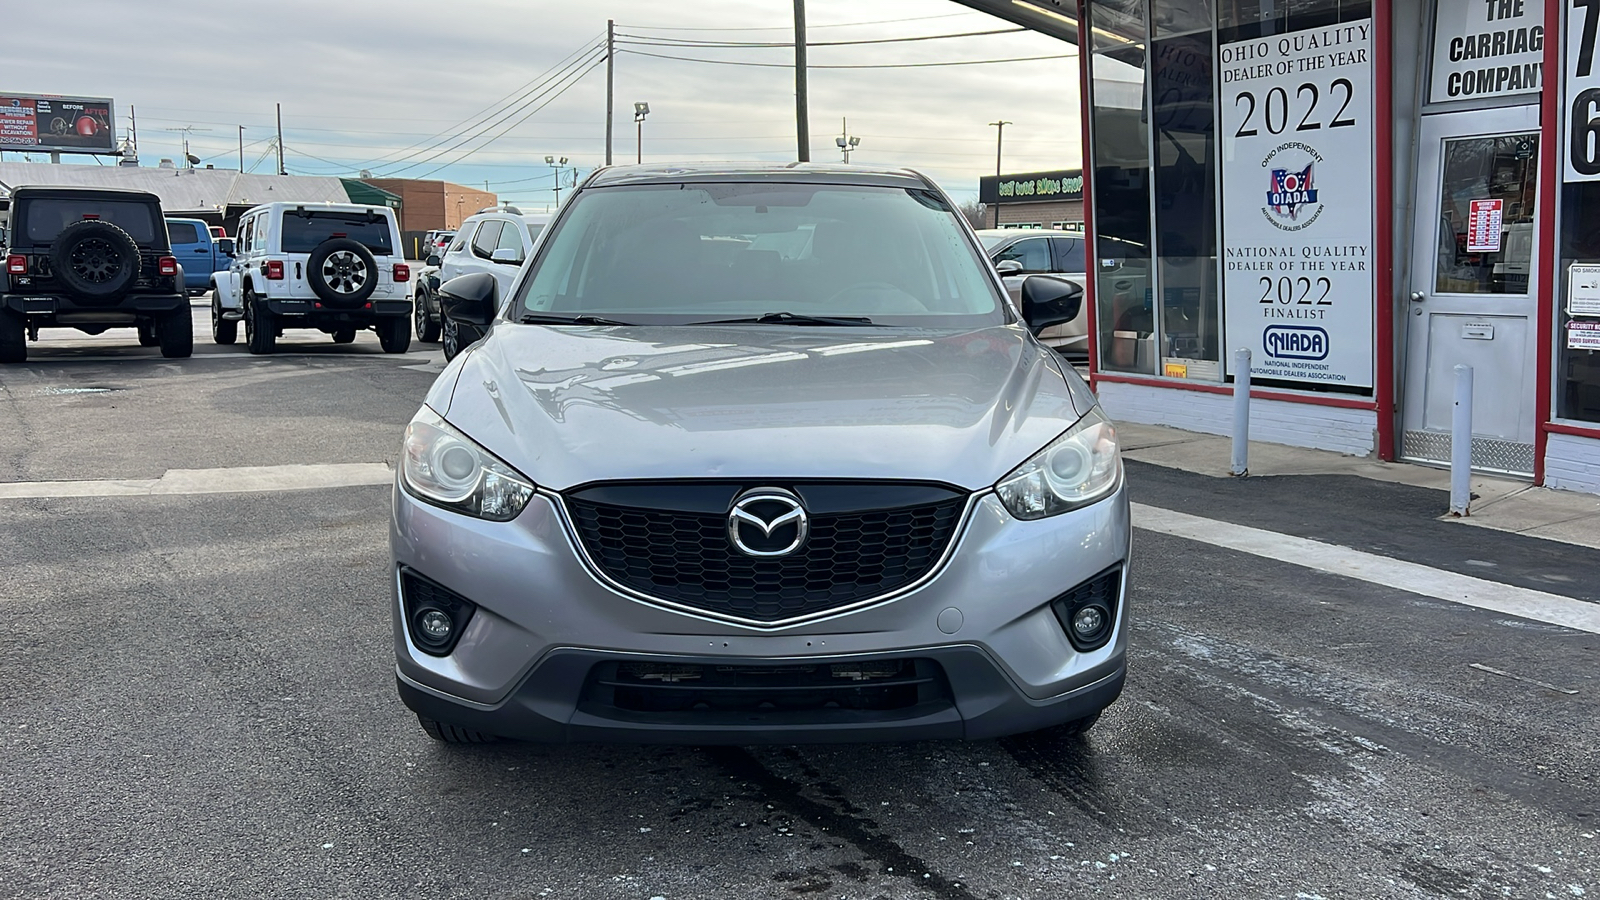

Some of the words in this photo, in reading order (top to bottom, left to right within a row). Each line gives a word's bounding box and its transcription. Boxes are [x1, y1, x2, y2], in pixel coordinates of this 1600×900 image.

[1486, 0, 1524, 21] THE
[1221, 42, 1269, 64] OHIO
[1278, 24, 1370, 56] QUALITY
[1449, 25, 1544, 62] CARRIAG
[1224, 63, 1273, 83] DEALER
[1276, 60, 1294, 75] OF
[1297, 55, 1325, 72] THE
[1329, 48, 1368, 67] YEAR
[84, 108, 108, 116] AFTER
[1235, 77, 1356, 138] 2022
[1261, 149, 1277, 168] OHIO
[1276, 141, 1324, 163] INDEPENDENT
[1272, 191, 1310, 205] OIADA
[1261, 207, 1283, 230] AUTOMOBILE
[1301, 203, 1325, 229] ASSOCIATION
[1226, 247, 1296, 257] NATIONAL
[1302, 246, 1368, 258] QUALITY
[1228, 262, 1274, 271] DEALER
[1279, 262, 1295, 271] OF
[1300, 262, 1325, 271] THE
[1331, 262, 1366, 271] YEAR
[1259, 276, 1333, 306] 2022
[1264, 308, 1326, 319] FINALIST
[1268, 333, 1323, 353] NIADA
[1250, 368, 1282, 376] AUTOMOBILE
[1308, 373, 1346, 381] ASSOCIATION
[1264, 360, 1290, 368] NATIONAL
[1291, 362, 1329, 371] INDEPENDENT
